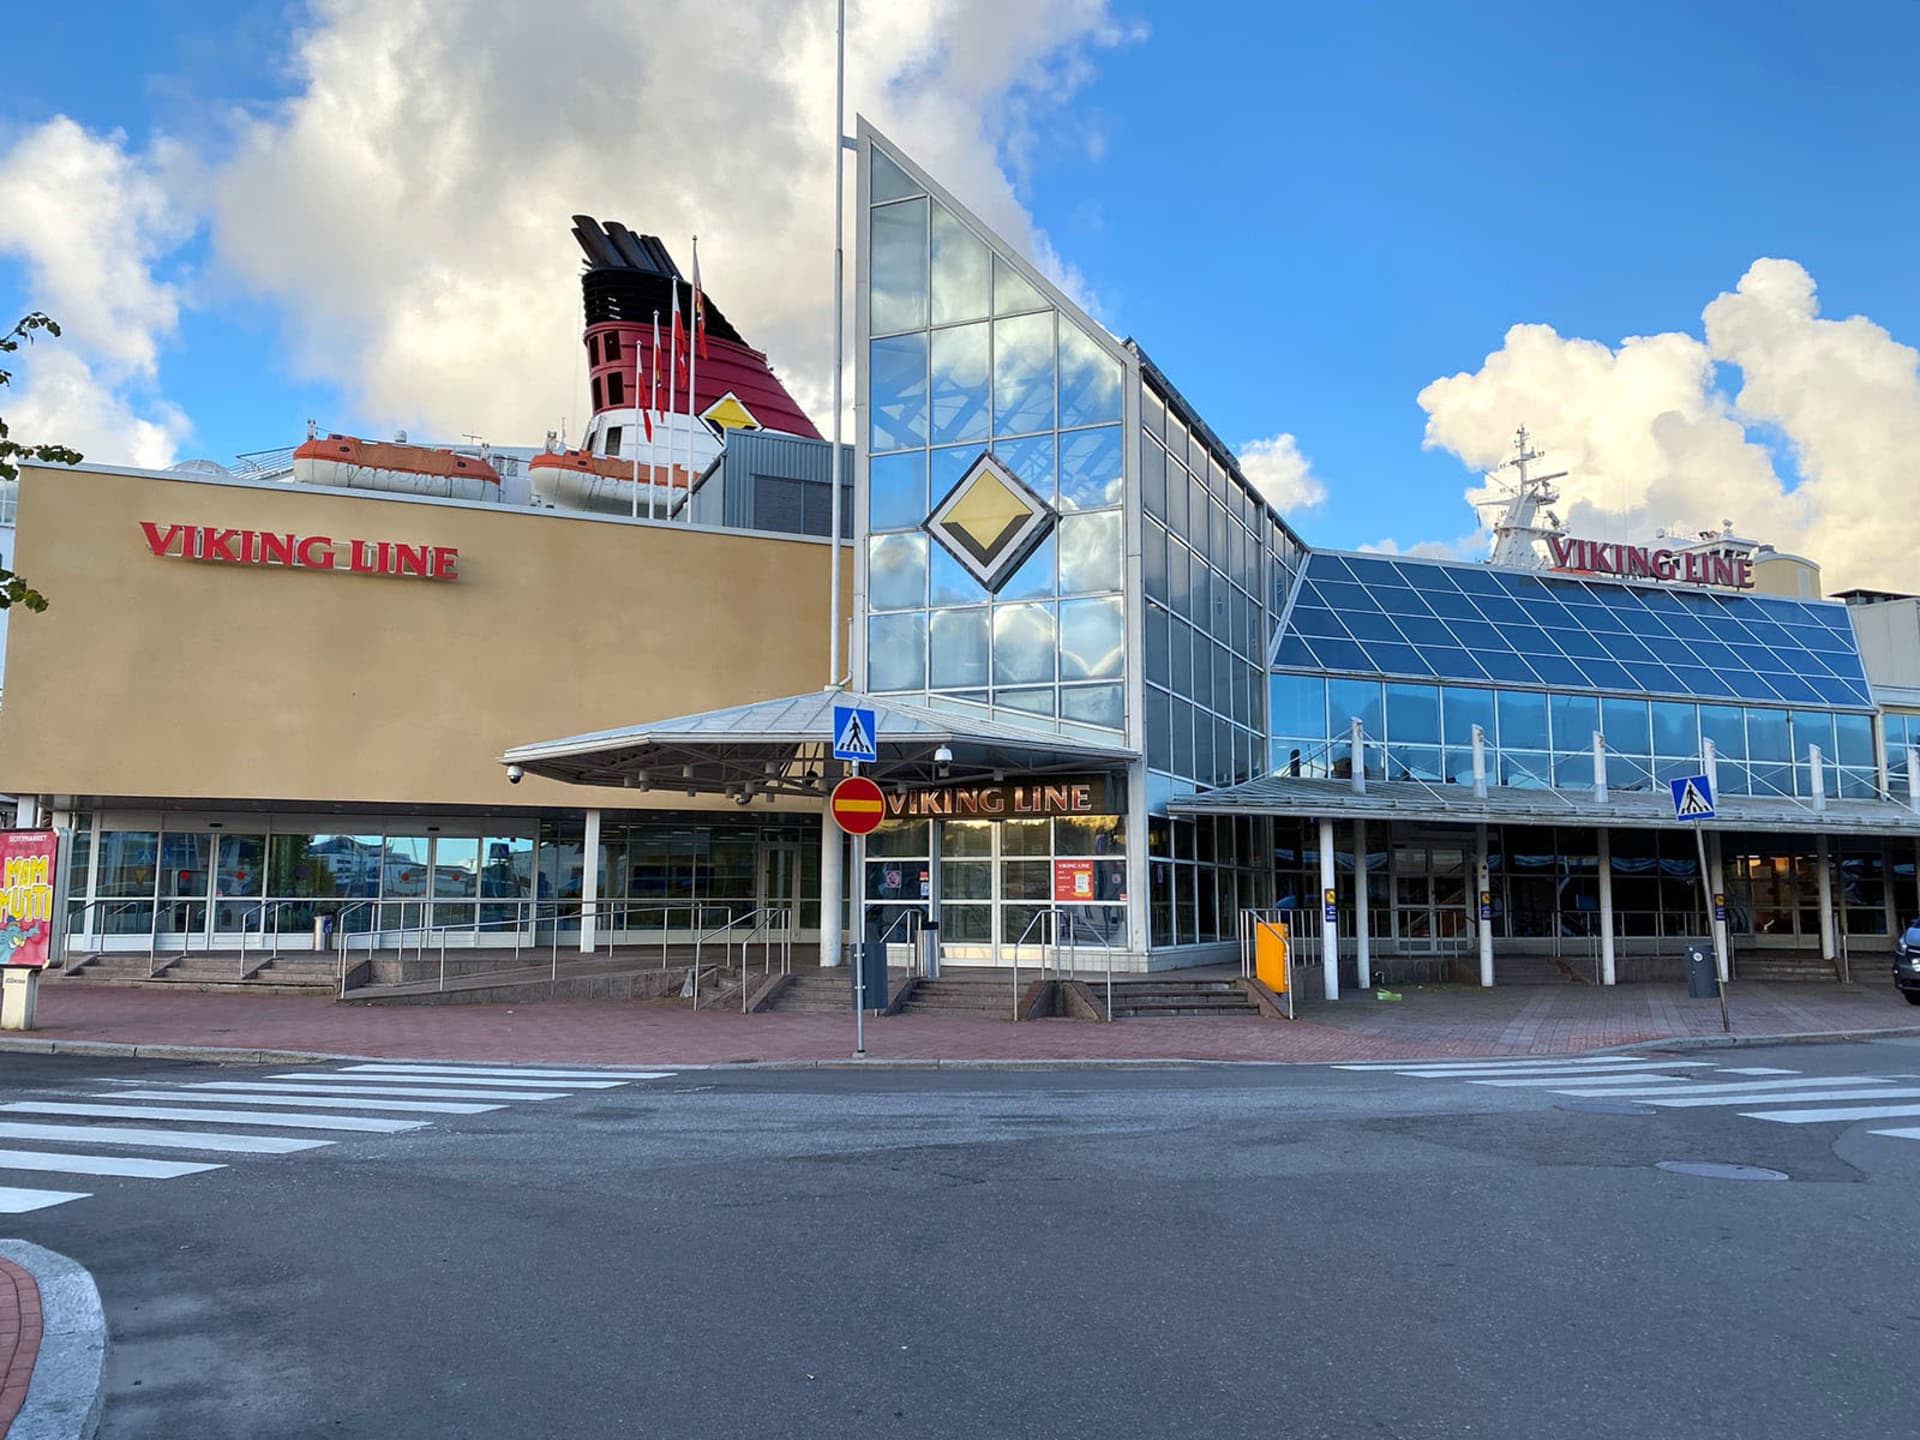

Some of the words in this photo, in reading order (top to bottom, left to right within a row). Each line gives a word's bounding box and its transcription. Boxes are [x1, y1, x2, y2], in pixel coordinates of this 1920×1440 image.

[139, 521, 335, 569] VIKING
[351, 540, 459, 577] LINE
[1550, 536, 1676, 580] VIKING
[1683, 552, 1755, 588] LINE
[887, 787, 1005, 815] VIKING
[1014, 784, 1092, 812] LINE
[4, 855, 49, 889] MAM
[0, 884, 53, 922] MUTTI
